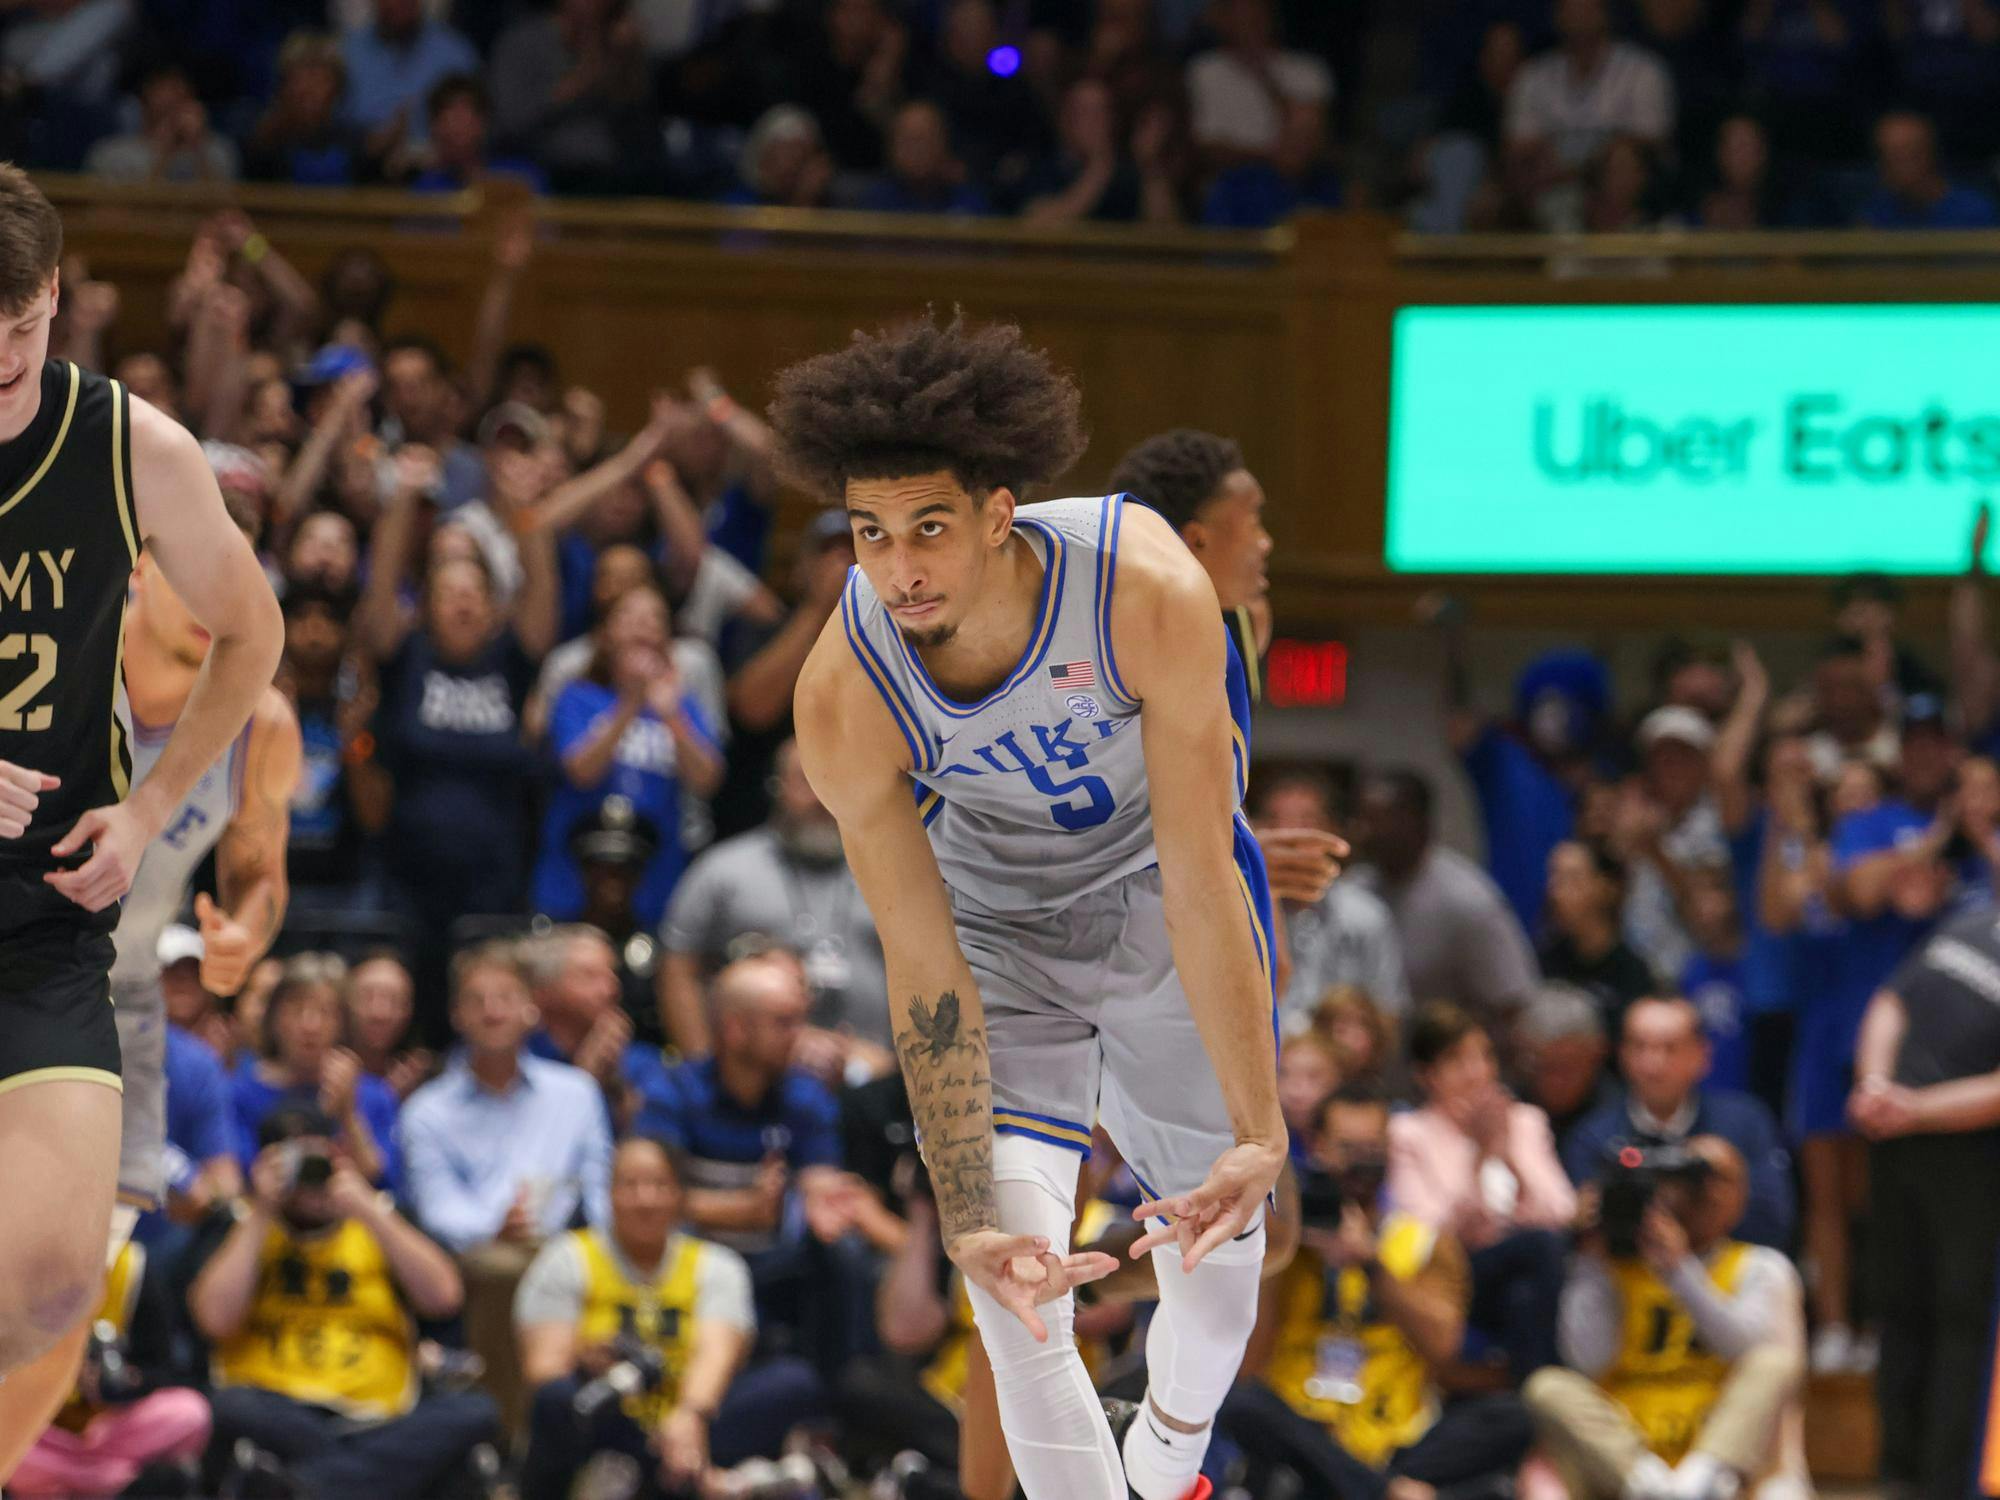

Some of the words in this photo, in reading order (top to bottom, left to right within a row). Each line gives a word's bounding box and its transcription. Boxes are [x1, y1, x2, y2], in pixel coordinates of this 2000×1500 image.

[1532, 395, 1755, 484] Uber
[1785, 393, 2000, 484] Eats
[0, 633, 58, 731] 2
[934, 717, 1134, 778] UK
[1025, 750, 1116, 831] 5
